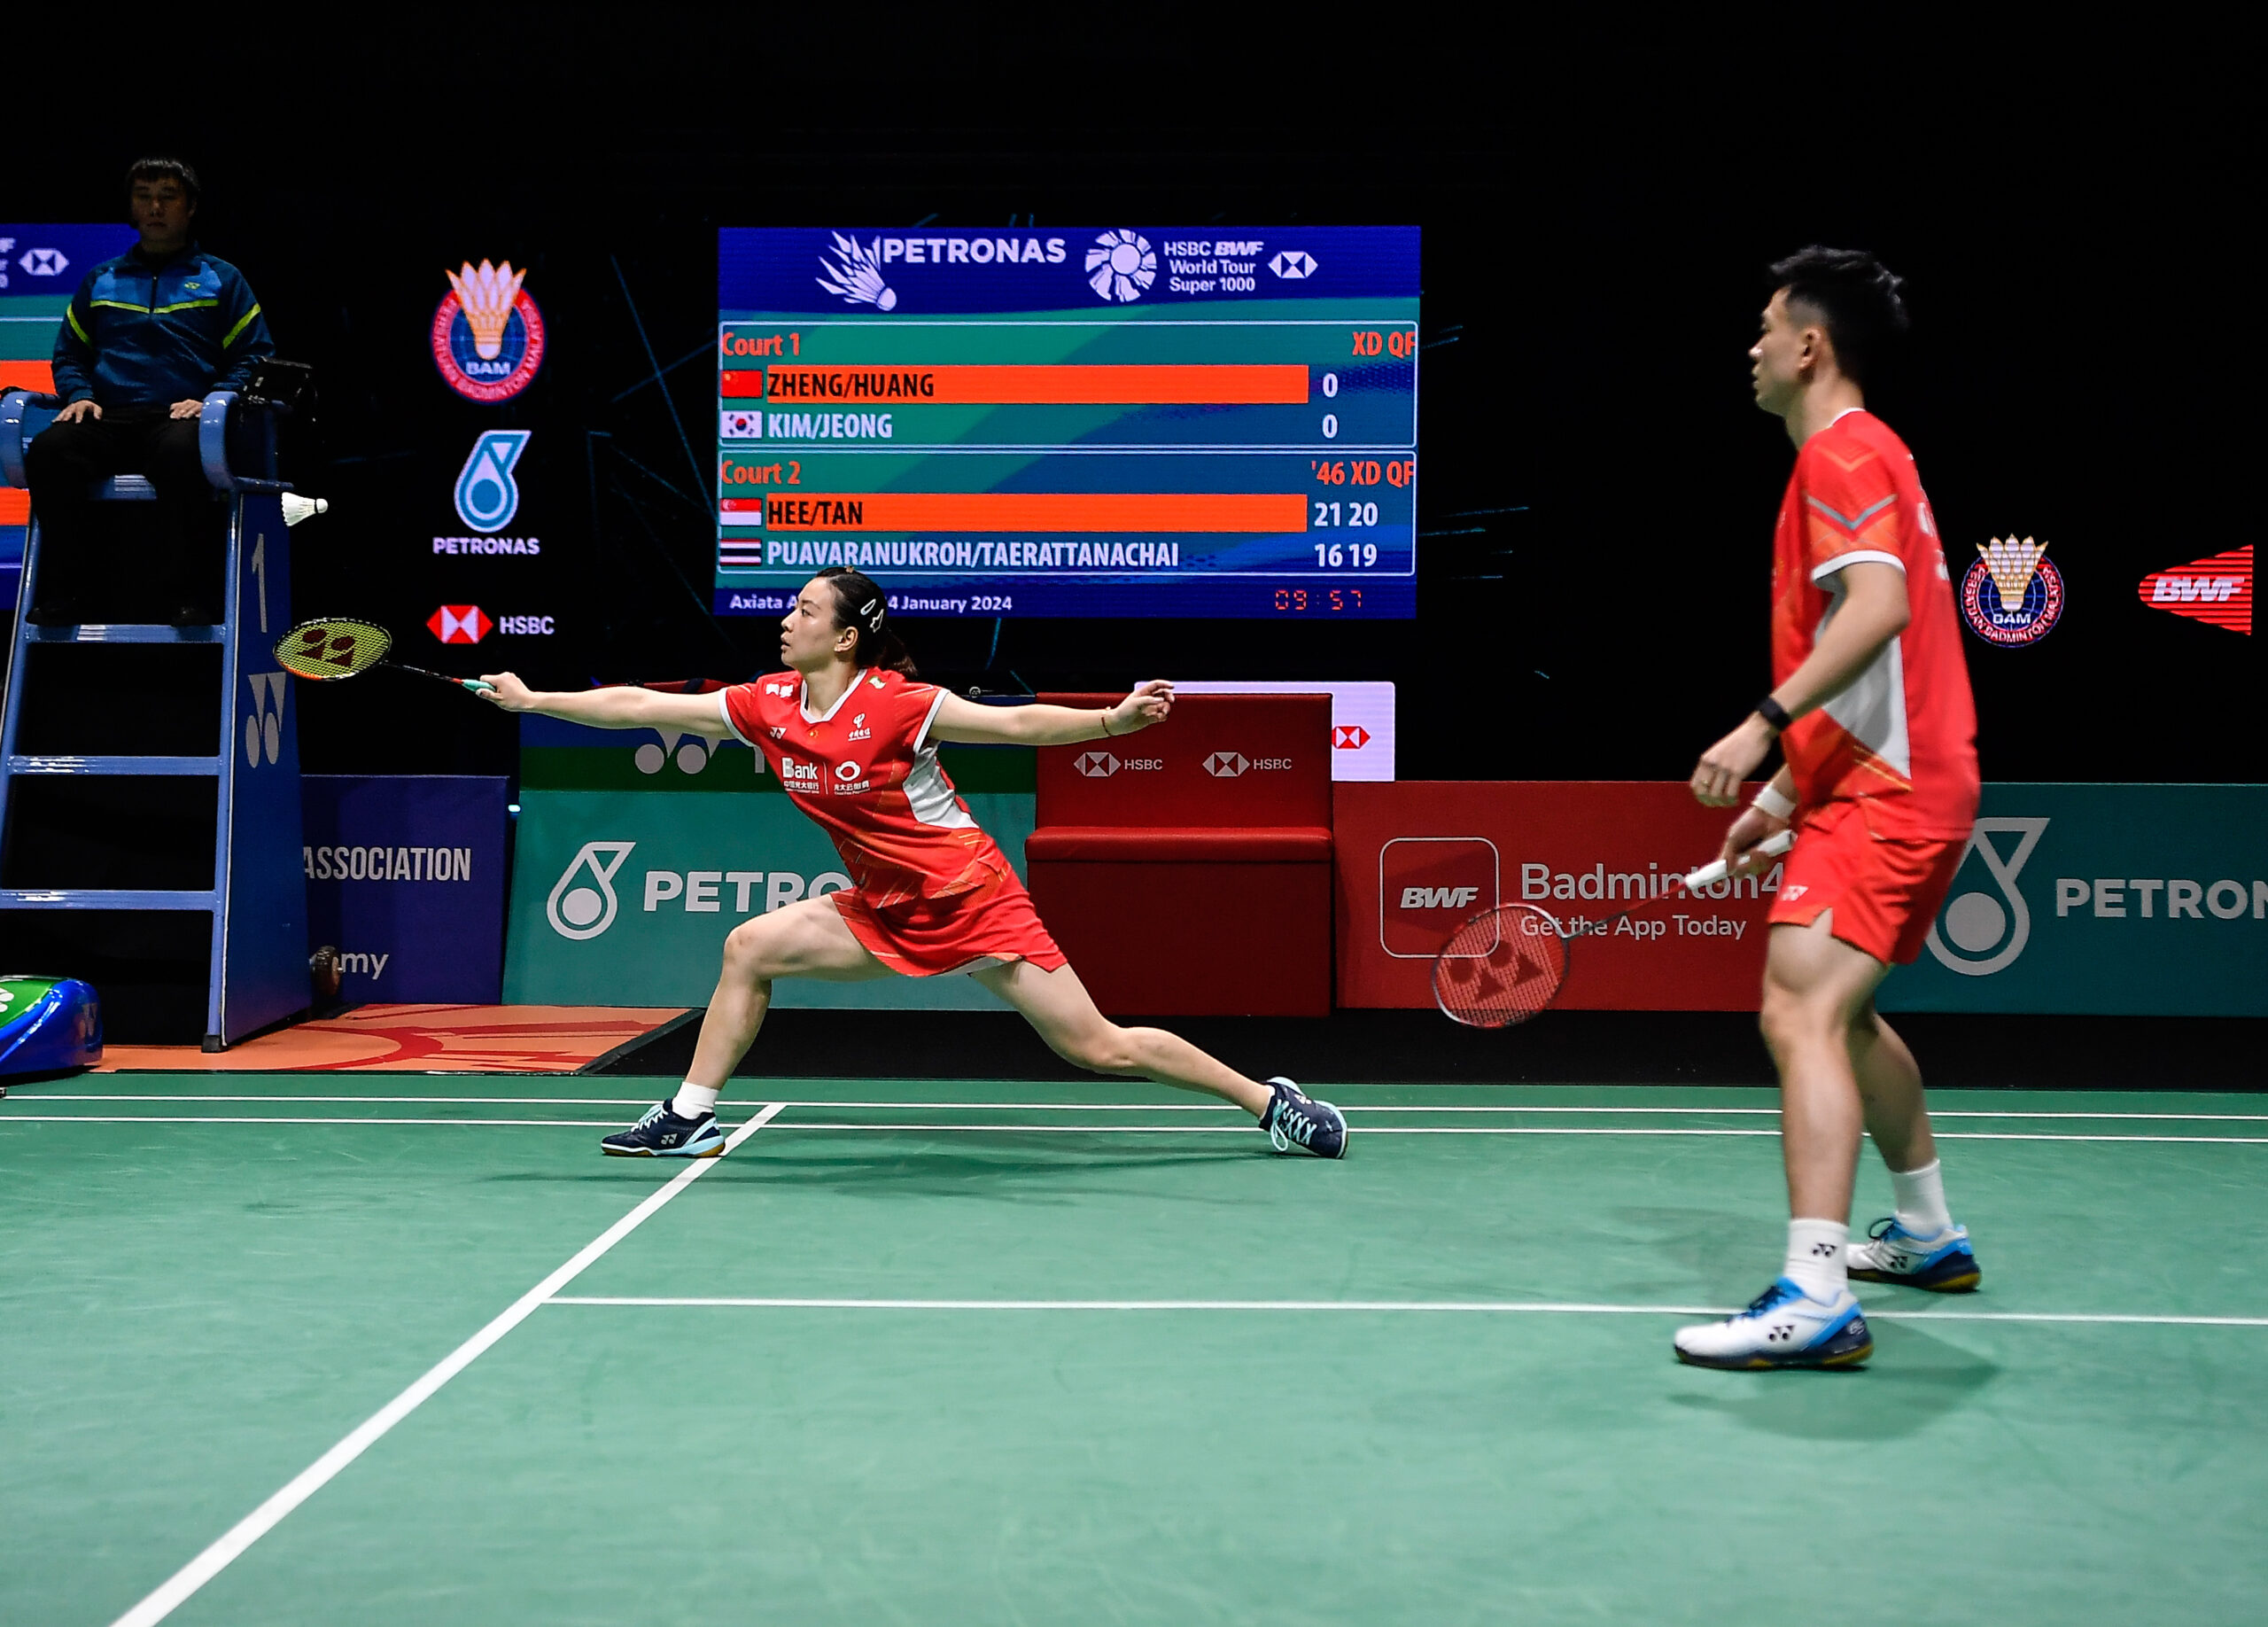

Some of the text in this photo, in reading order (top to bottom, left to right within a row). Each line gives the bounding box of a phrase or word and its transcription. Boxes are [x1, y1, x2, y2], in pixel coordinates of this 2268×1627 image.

[883, 238, 1066, 263] PETRONAS
[1164, 241, 1264, 256] HSBC BWF
[1169, 259, 1256, 275] World Tour
[1169, 276, 1255, 295] Super 1000
[721, 333, 800, 356] Court 1
[1352, 331, 1416, 359] XD QF
[465, 361, 511, 375] BAM
[767, 373, 934, 398] ZHENG/HUANG
[1323, 373, 1338, 397] 0
[768, 414, 892, 439] KIM/JEONG
[1323, 415, 1338, 438] 0
[721, 462, 801, 485] Court 2
[1351, 461, 1381, 485] XD
[1386, 461, 1415, 488] QF
[767, 501, 863, 526] HEE/TAN
[1315, 502, 1378, 526] 21 20
[432, 537, 540, 555] PETRONAS
[768, 541, 1178, 568] PUAVARANUKROH/TAERATTANACHAI
[1315, 543, 1377, 567] 16 19
[2153, 576, 2245, 602] BWF
[730, 595, 783, 610] Axiata
[901, 596, 967, 613] January
[971, 596, 1013, 611] 2024
[500, 616, 555, 634] HSBC
[781, 757, 819, 780] Bank
[1124, 759, 1163, 770] HSBC
[1253, 759, 1293, 770] HSBC
[303, 846, 471, 881] ASSOCIATION
[1401, 887, 1479, 908] BWF
[1569, 915, 1608, 936] the
[1614, 915, 1666, 940] App
[1672, 915, 1746, 940] Today
